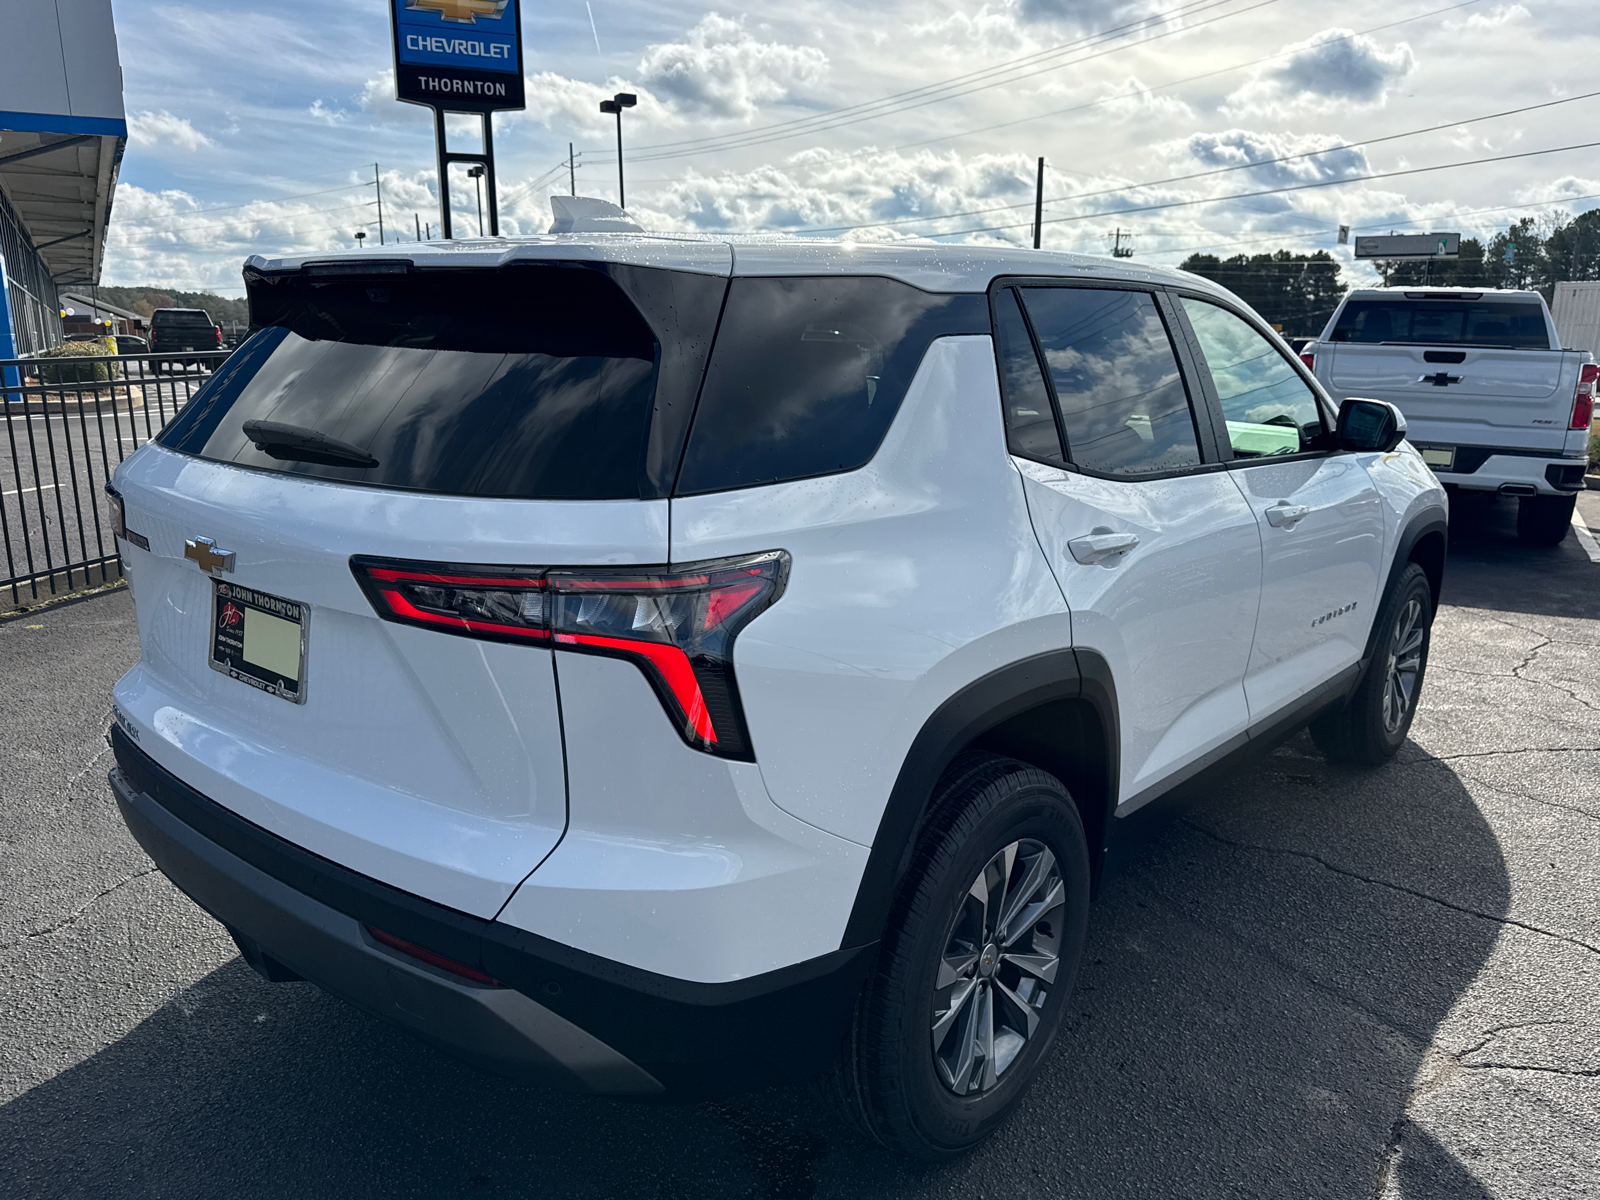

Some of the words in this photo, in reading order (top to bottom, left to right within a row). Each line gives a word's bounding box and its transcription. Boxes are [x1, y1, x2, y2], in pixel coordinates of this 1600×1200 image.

[406, 34, 511, 59] CHEVROLET
[418, 76, 506, 96] THORNTON
[232, 585, 253, 603] JOHN
[254, 593, 299, 619] THORNTON
[238, 673, 266, 690] CHEVROLET
